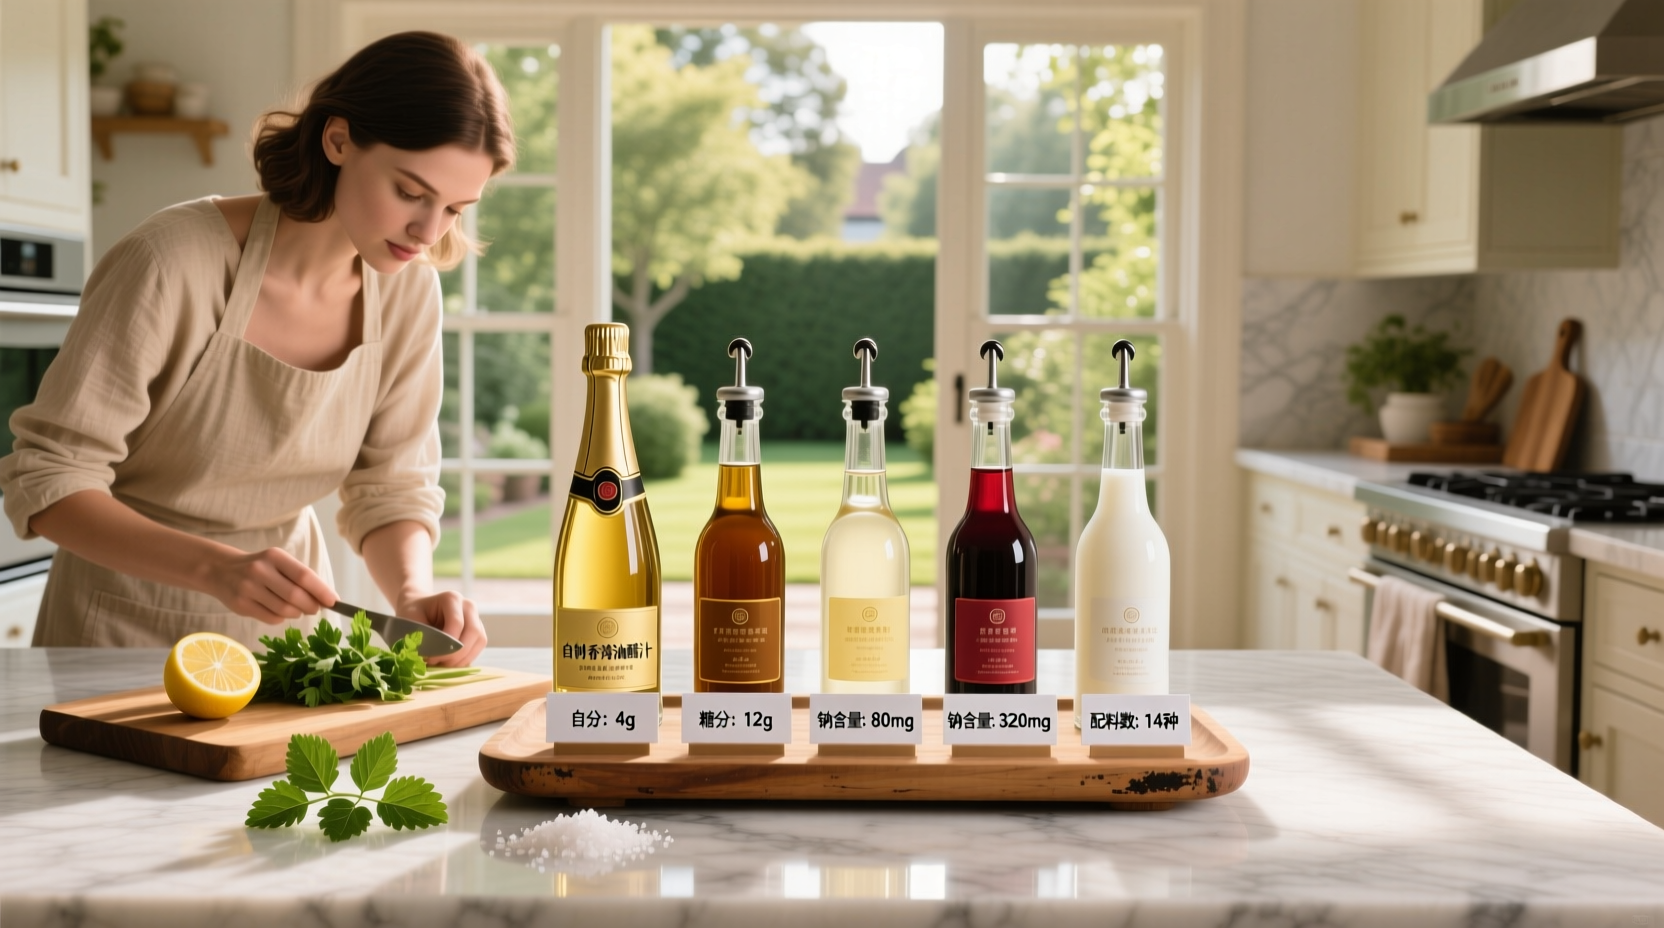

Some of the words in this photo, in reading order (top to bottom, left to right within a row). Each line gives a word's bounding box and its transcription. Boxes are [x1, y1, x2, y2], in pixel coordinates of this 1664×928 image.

[615, 710, 636, 732] 4g
[744, 711, 773, 732] 12g
[871, 711, 914, 732] 80mg
[999, 712, 1051, 732] 320mg
[1144, 711, 1179, 731] 14种
